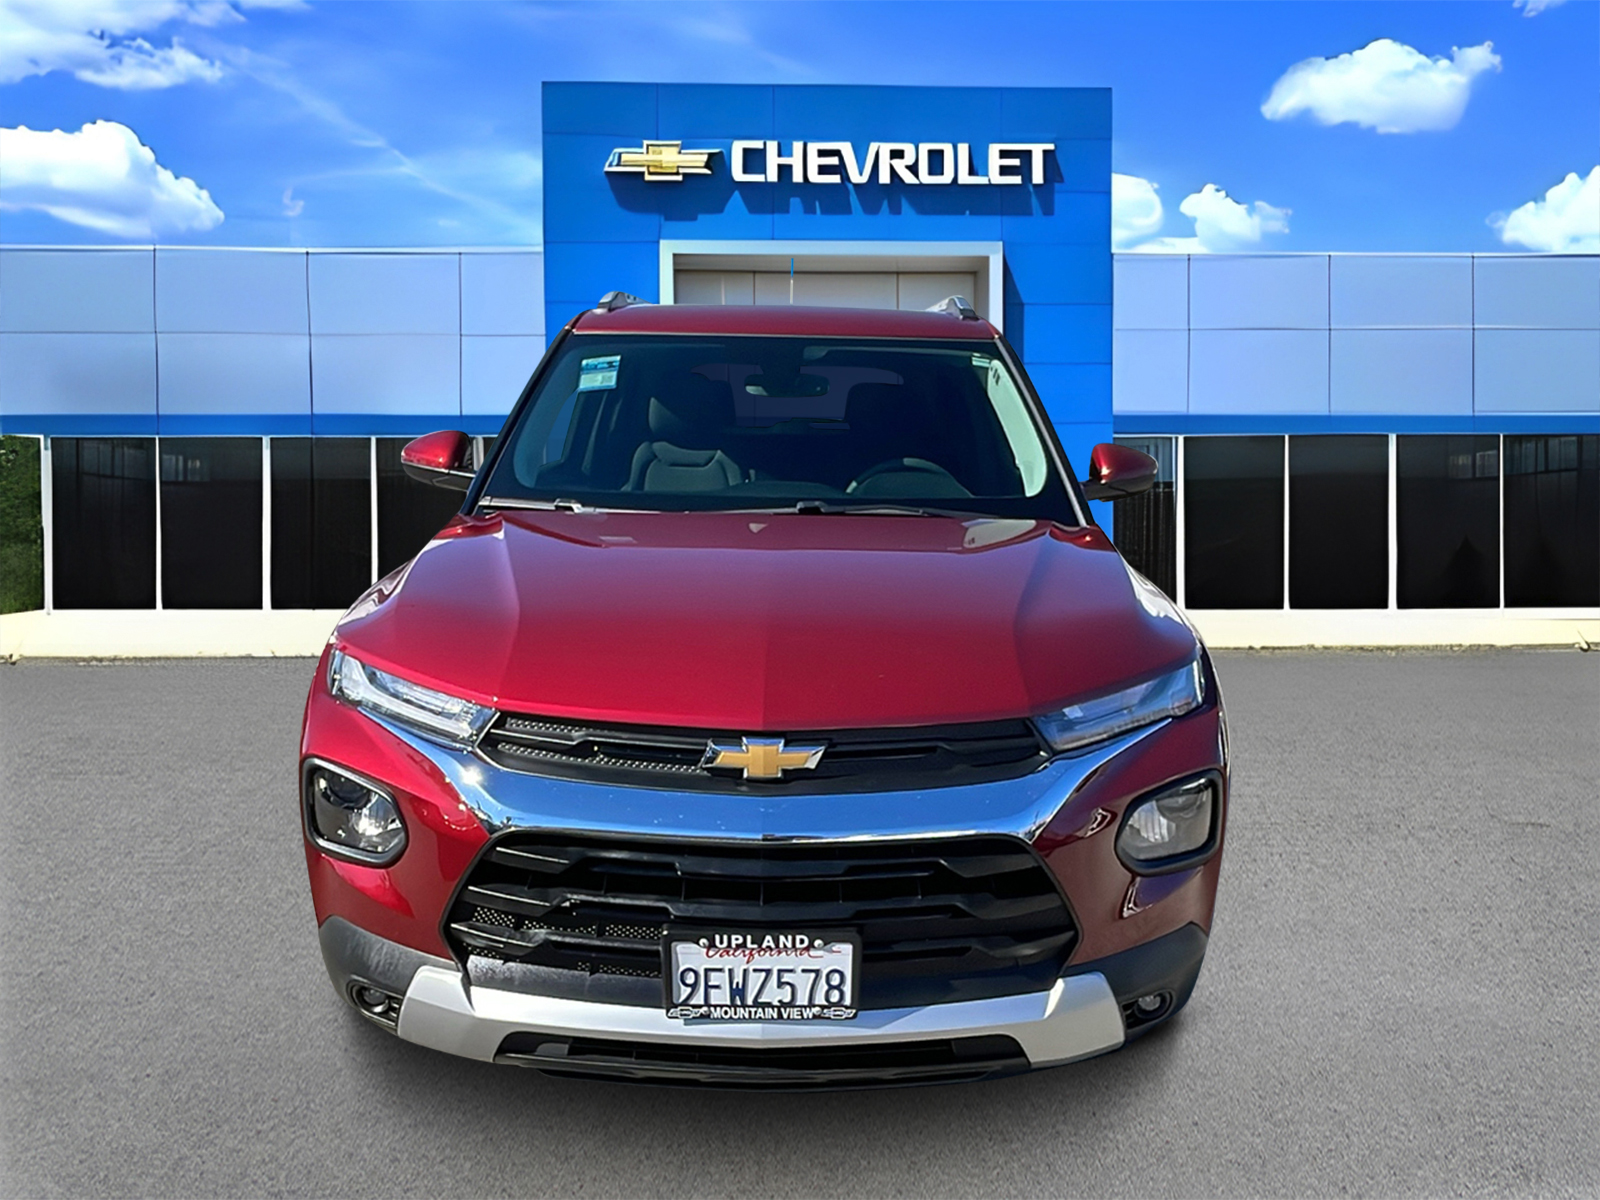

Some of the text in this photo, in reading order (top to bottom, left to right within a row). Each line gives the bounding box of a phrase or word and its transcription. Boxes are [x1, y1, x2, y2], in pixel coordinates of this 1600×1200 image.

[731, 140, 1055, 186] CHEVROLET
[714, 934, 810, 949] UPLAND
[680, 967, 846, 1006] 9FWZ578
[710, 1006, 778, 1019] MOUNTAIN
[781, 1007, 813, 1019] VIEW
